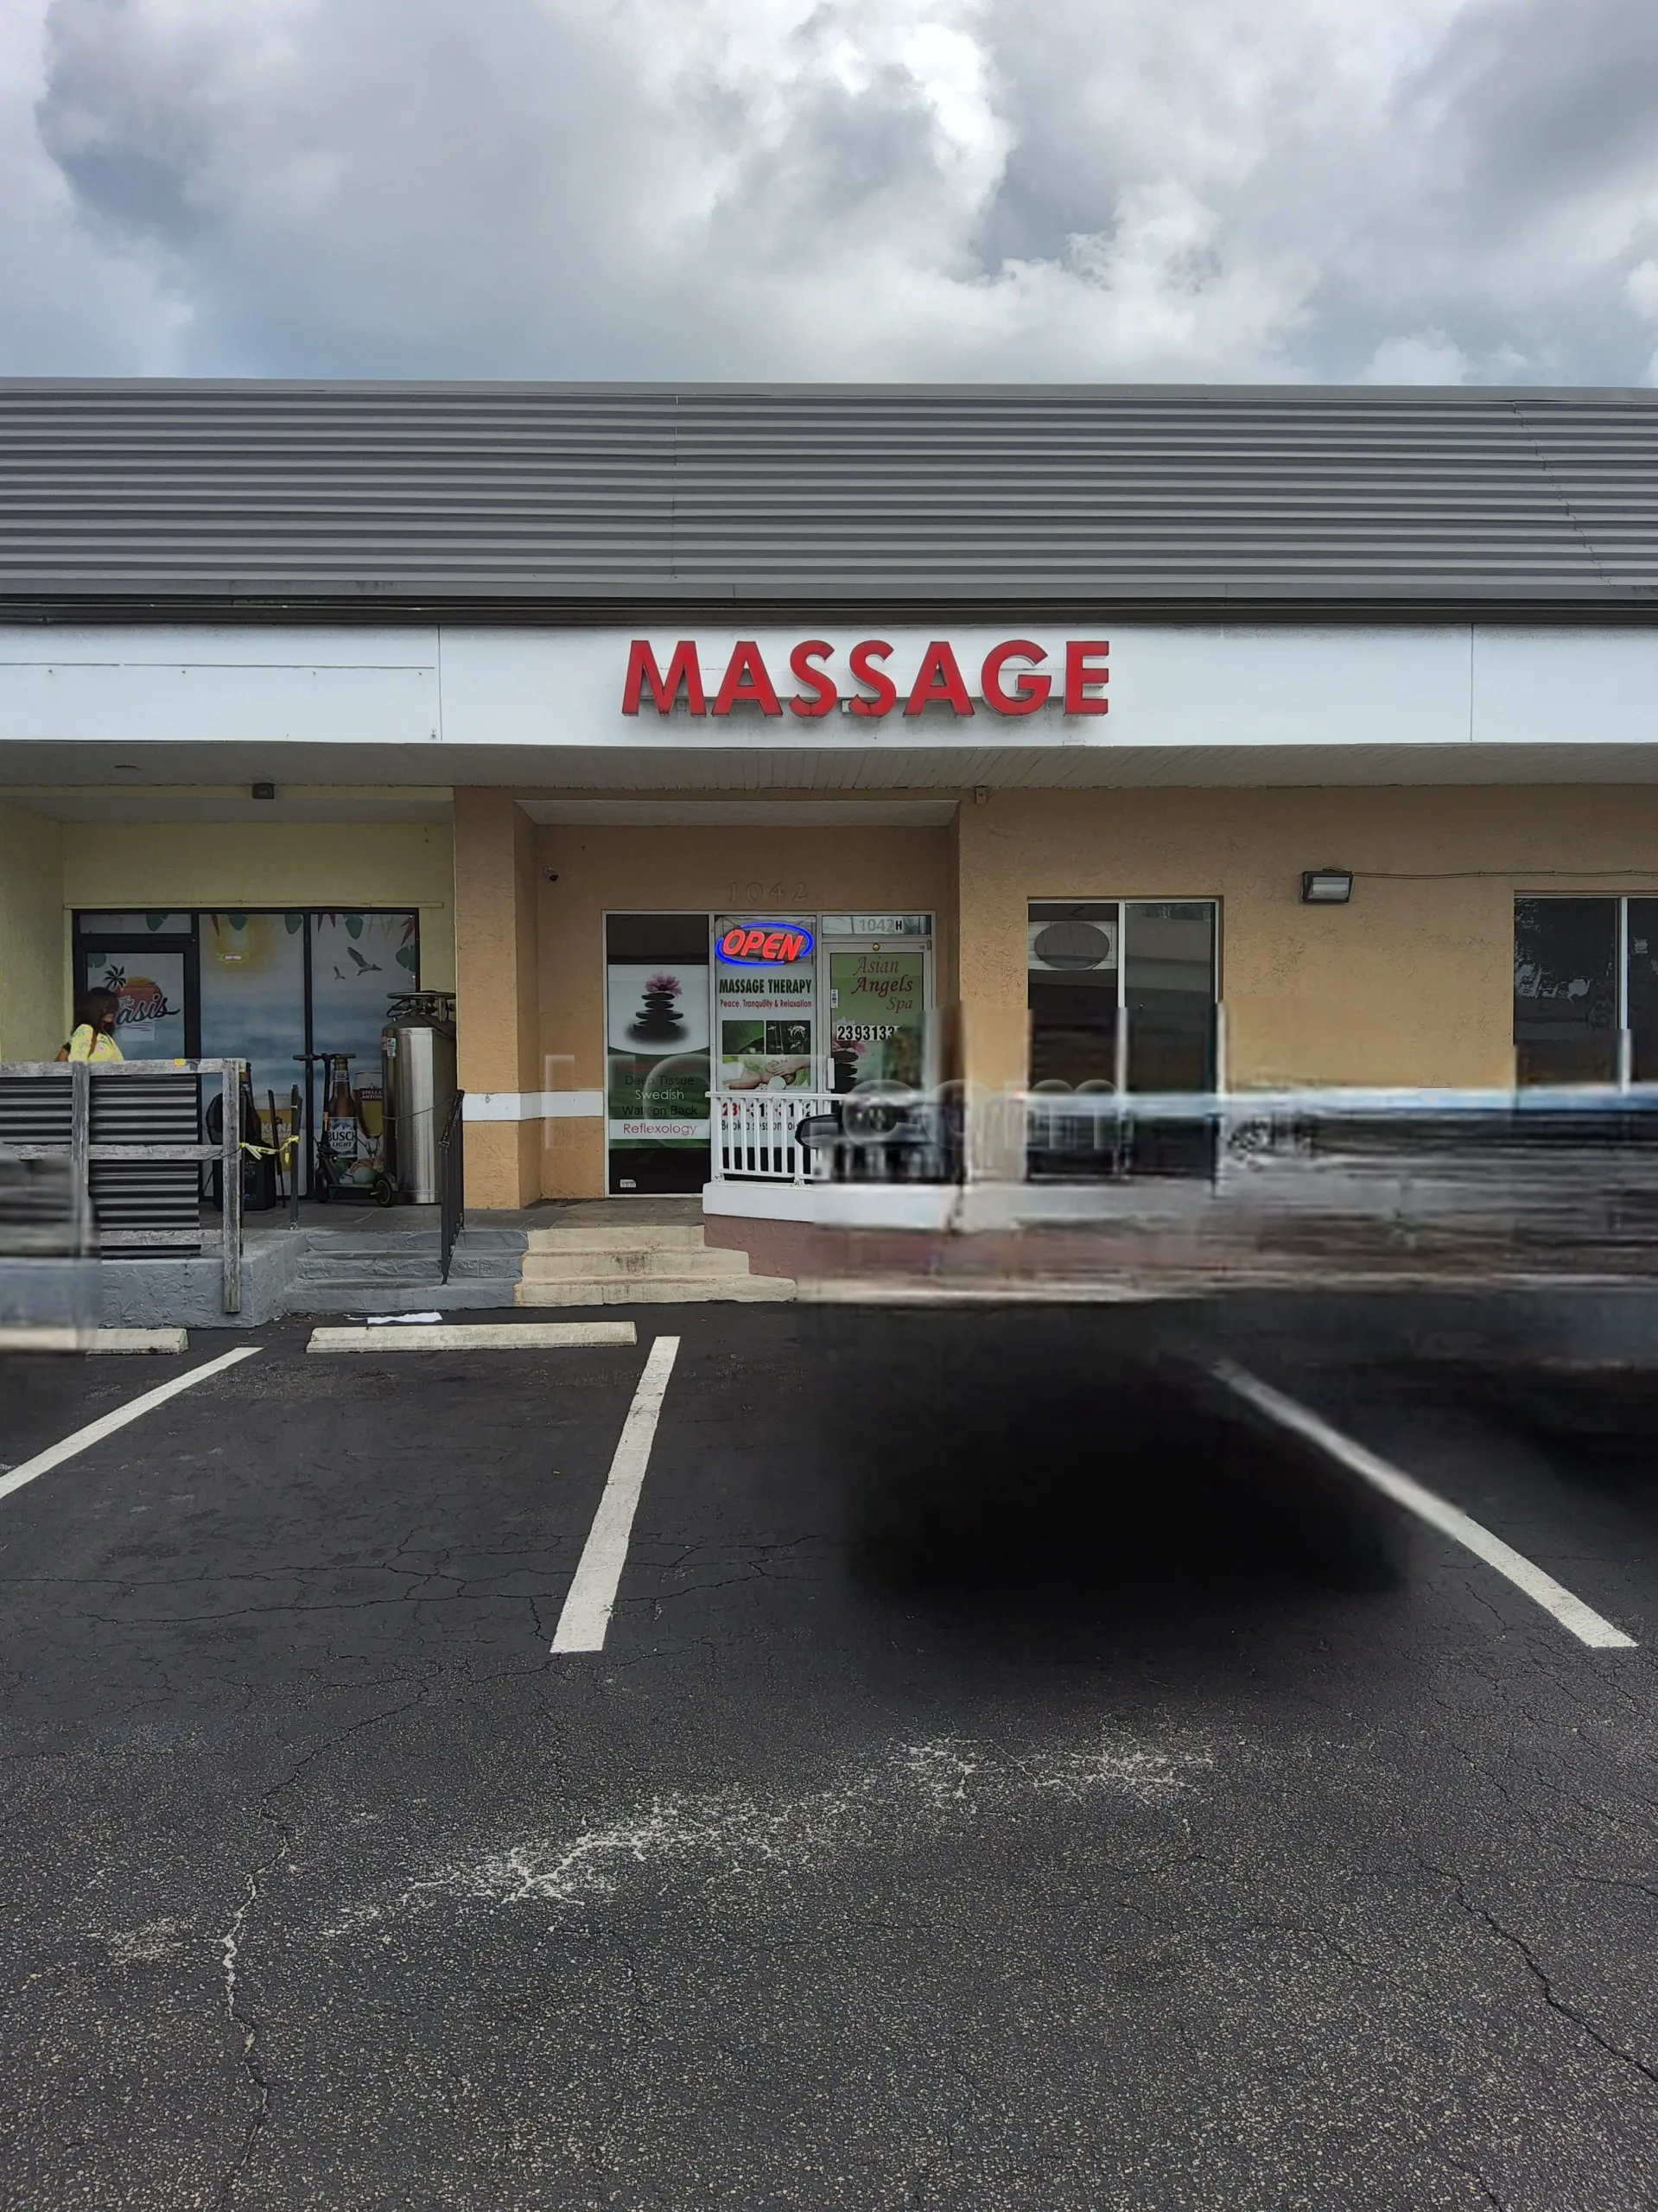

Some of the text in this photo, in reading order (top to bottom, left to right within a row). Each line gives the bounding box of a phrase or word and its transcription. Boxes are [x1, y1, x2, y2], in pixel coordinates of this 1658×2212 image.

[621, 639, 1110, 716] MASSAGE
[727, 881, 808, 902] 1042
[722, 929, 804, 961] OPEN
[852, 956, 899, 976] Asian
[719, 979, 812, 994] MASSAGE THERAPY
[851, 976, 913, 997] Angels
[116, 995, 181, 1026] asis
[743, 1000, 772, 1009] Tranquility
[886, 997, 913, 1014] Spa
[658, 1075, 695, 1085] Tissue
[634, 1090, 684, 1100] Swedish
[670, 1105, 697, 1116] Back
[327, 1131, 357, 1141] BUSCH
[623, 1123, 697, 1135] Reflexology
